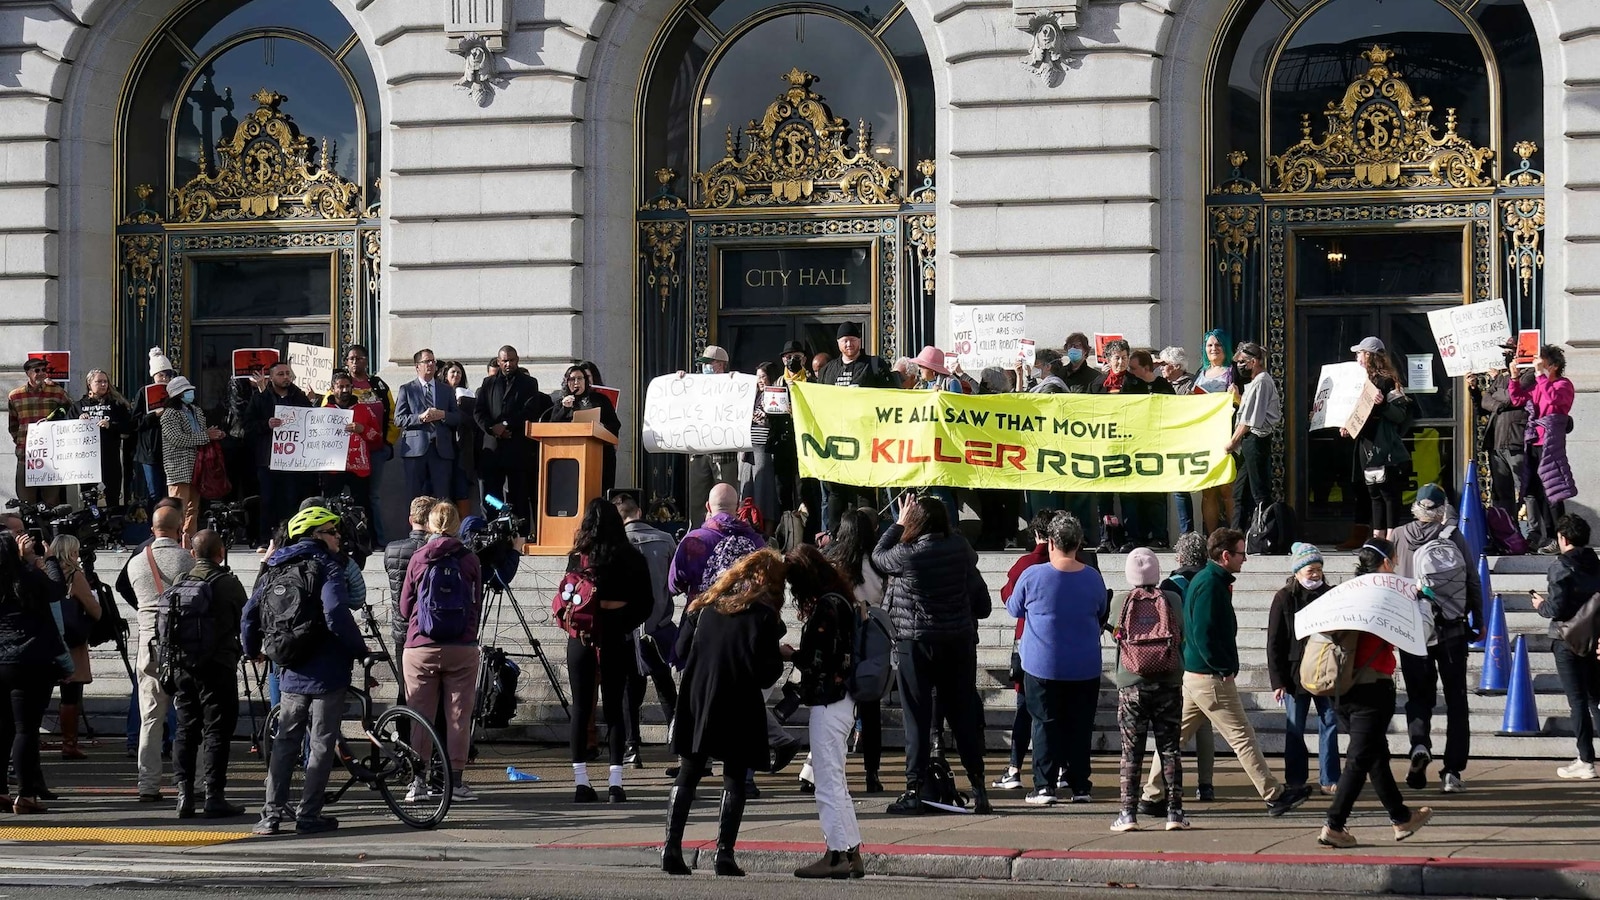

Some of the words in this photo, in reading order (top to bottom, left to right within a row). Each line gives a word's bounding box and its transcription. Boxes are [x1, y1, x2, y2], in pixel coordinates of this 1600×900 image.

[745, 268, 792, 287] CITY
[798, 268, 852, 286] HALL
[977, 313, 996, 323] BLANK
[998, 311, 1024, 322] CHECKS
[1477, 304, 1503, 319] CHECKS
[953, 330, 973, 341] VOTE
[996, 327, 1009, 336] AR-15
[979, 339, 997, 350] KILLER
[1438, 333, 1454, 346] VOTE
[306, 346, 318, 356] NO
[954, 340, 971, 355] NO
[1439, 345, 1456, 358] NO
[313, 357, 333, 371] ROBOTS
[305, 367, 318, 378] NO
[650, 377, 695, 399] STOP
[310, 414, 326, 425] BLANK
[327, 414, 350, 425] CHECKS
[649, 404, 704, 425] POLICE
[714, 403, 750, 423] NEW
[72, 422, 95, 433] CHECKS
[875, 405, 904, 425] WE
[908, 404, 939, 424] ALL
[943, 408, 990, 428] SAW
[995, 413, 1047, 432] THAT
[1053, 419, 1133, 440] MOVIE...
[274, 430, 300, 442] VOTE
[273, 442, 296, 455] NO
[321, 440, 344, 450] ROBOTS
[27, 448, 48, 458] VOTE
[75, 451, 97, 459] ROBOTS
[801, 432, 860, 461] NO
[870, 437, 1027, 471] KILLER
[1036, 447, 1211, 479] ROBOTS
[27, 458, 45, 470] NO
[1372, 575, 1418, 602] CHECKS
